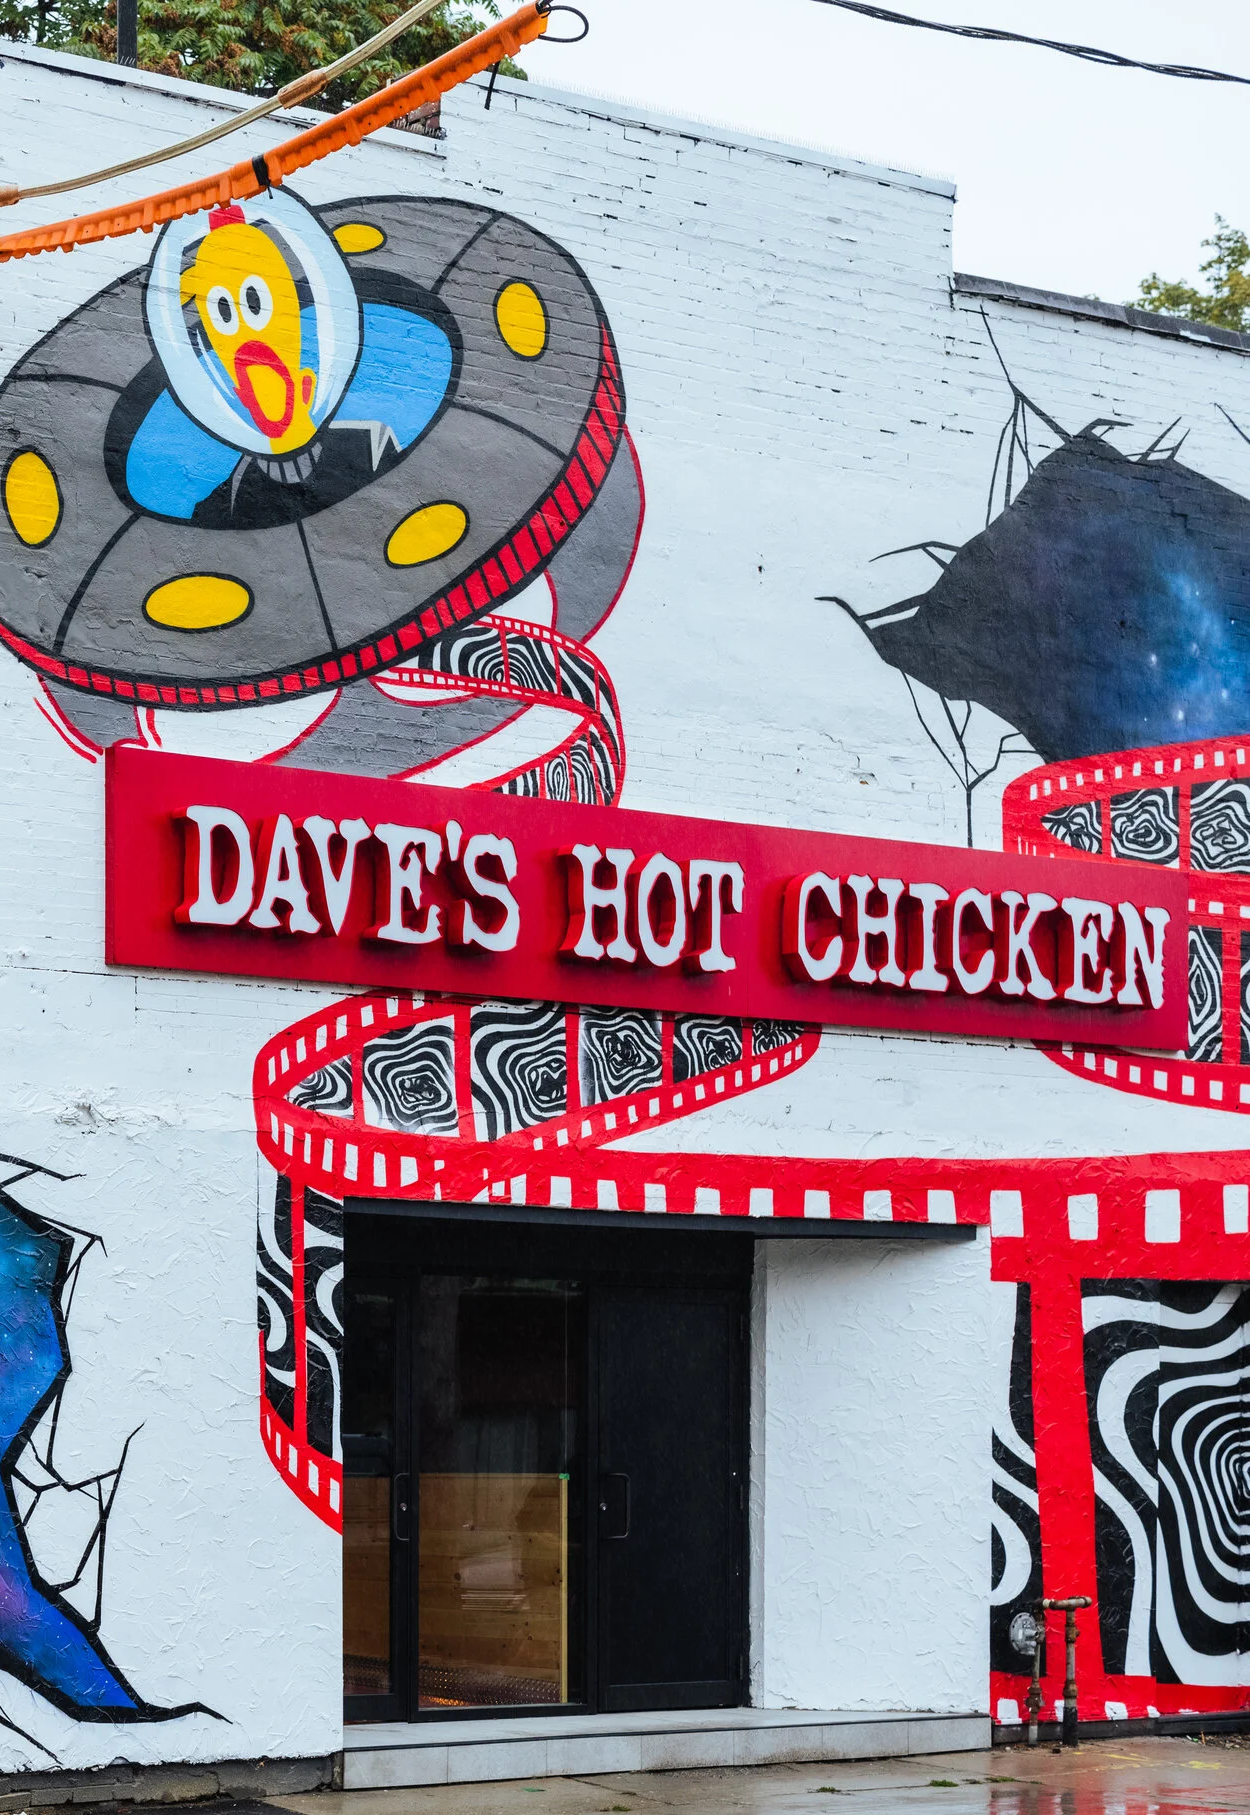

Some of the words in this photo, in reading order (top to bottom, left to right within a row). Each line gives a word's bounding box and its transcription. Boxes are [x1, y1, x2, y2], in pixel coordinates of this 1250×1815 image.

[184, 804, 520, 953] DAVE'S
[570, 843, 745, 973] HOT
[796, 871, 1171, 1010] CHICKEN
